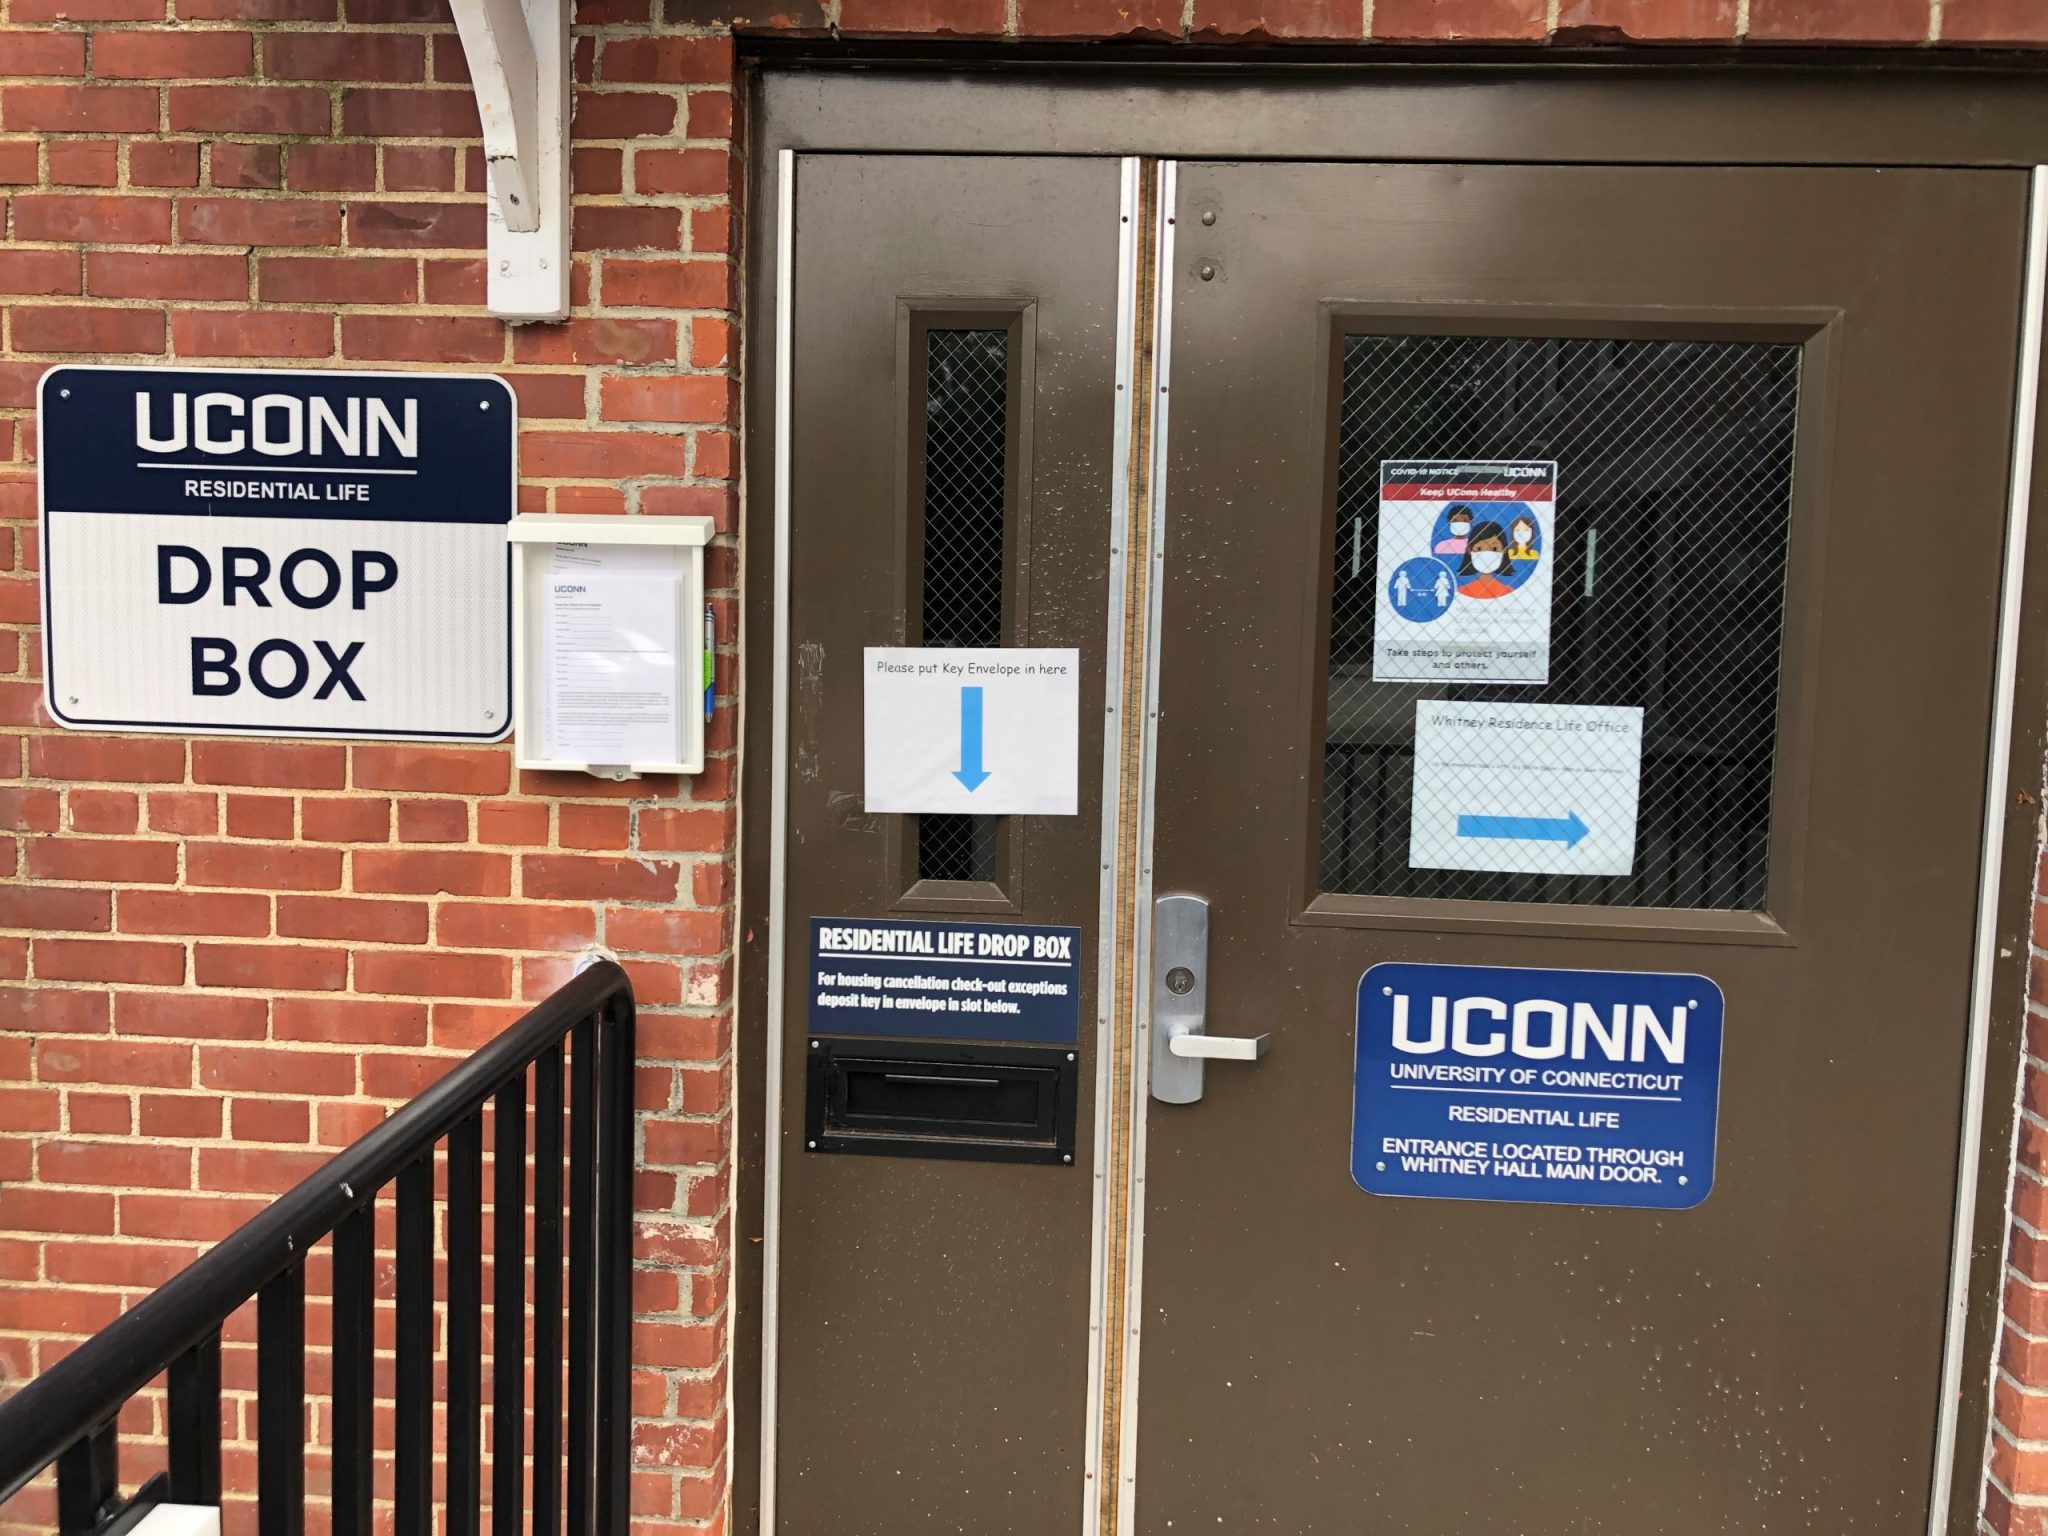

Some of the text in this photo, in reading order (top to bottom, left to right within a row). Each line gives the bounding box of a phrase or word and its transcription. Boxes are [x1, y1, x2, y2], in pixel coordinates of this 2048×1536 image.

[136, 391, 418, 458] UCONN
[1390, 468, 1460, 476] COVID-19 NOTICE
[1503, 467, 1547, 477] UCONN
[185, 480, 371, 502] RESIDENTIAL LIFE
[1420, 488, 1517, 498] Keep UConn Healthy
[157, 544, 399, 610] DROP
[554, 585, 586, 593] UCONN
[1386, 648, 1536, 661] Take steps to protect yourself
[1432, 661, 1488, 670] and others.
[191, 636, 367, 702] BOX
[877, 661, 1068, 677] Please put Key Envelope in here
[1431, 715, 1630, 733] Whitney Residence Life Office
[819, 927, 1071, 959] RESIDENTIAL LIFE DROP BOX
[818, 972, 1067, 997] For housing cancellation check-out exceptions
[817, 993, 1021, 1015] deposit key in envelope in slot below.
[1391, 994, 1687, 1064] UCONN
[1390, 1063, 1683, 1091] UNIVERSITY OF CONNECTICUT
[1448, 1105, 1619, 1129] RESIDENTIAL LIFE
[1382, 1137, 1684, 1167] ENTRANCE LOCATED THROUGH
[1400, 1155, 1662, 1184] WHITNEY HALL MAIN DOOR.
